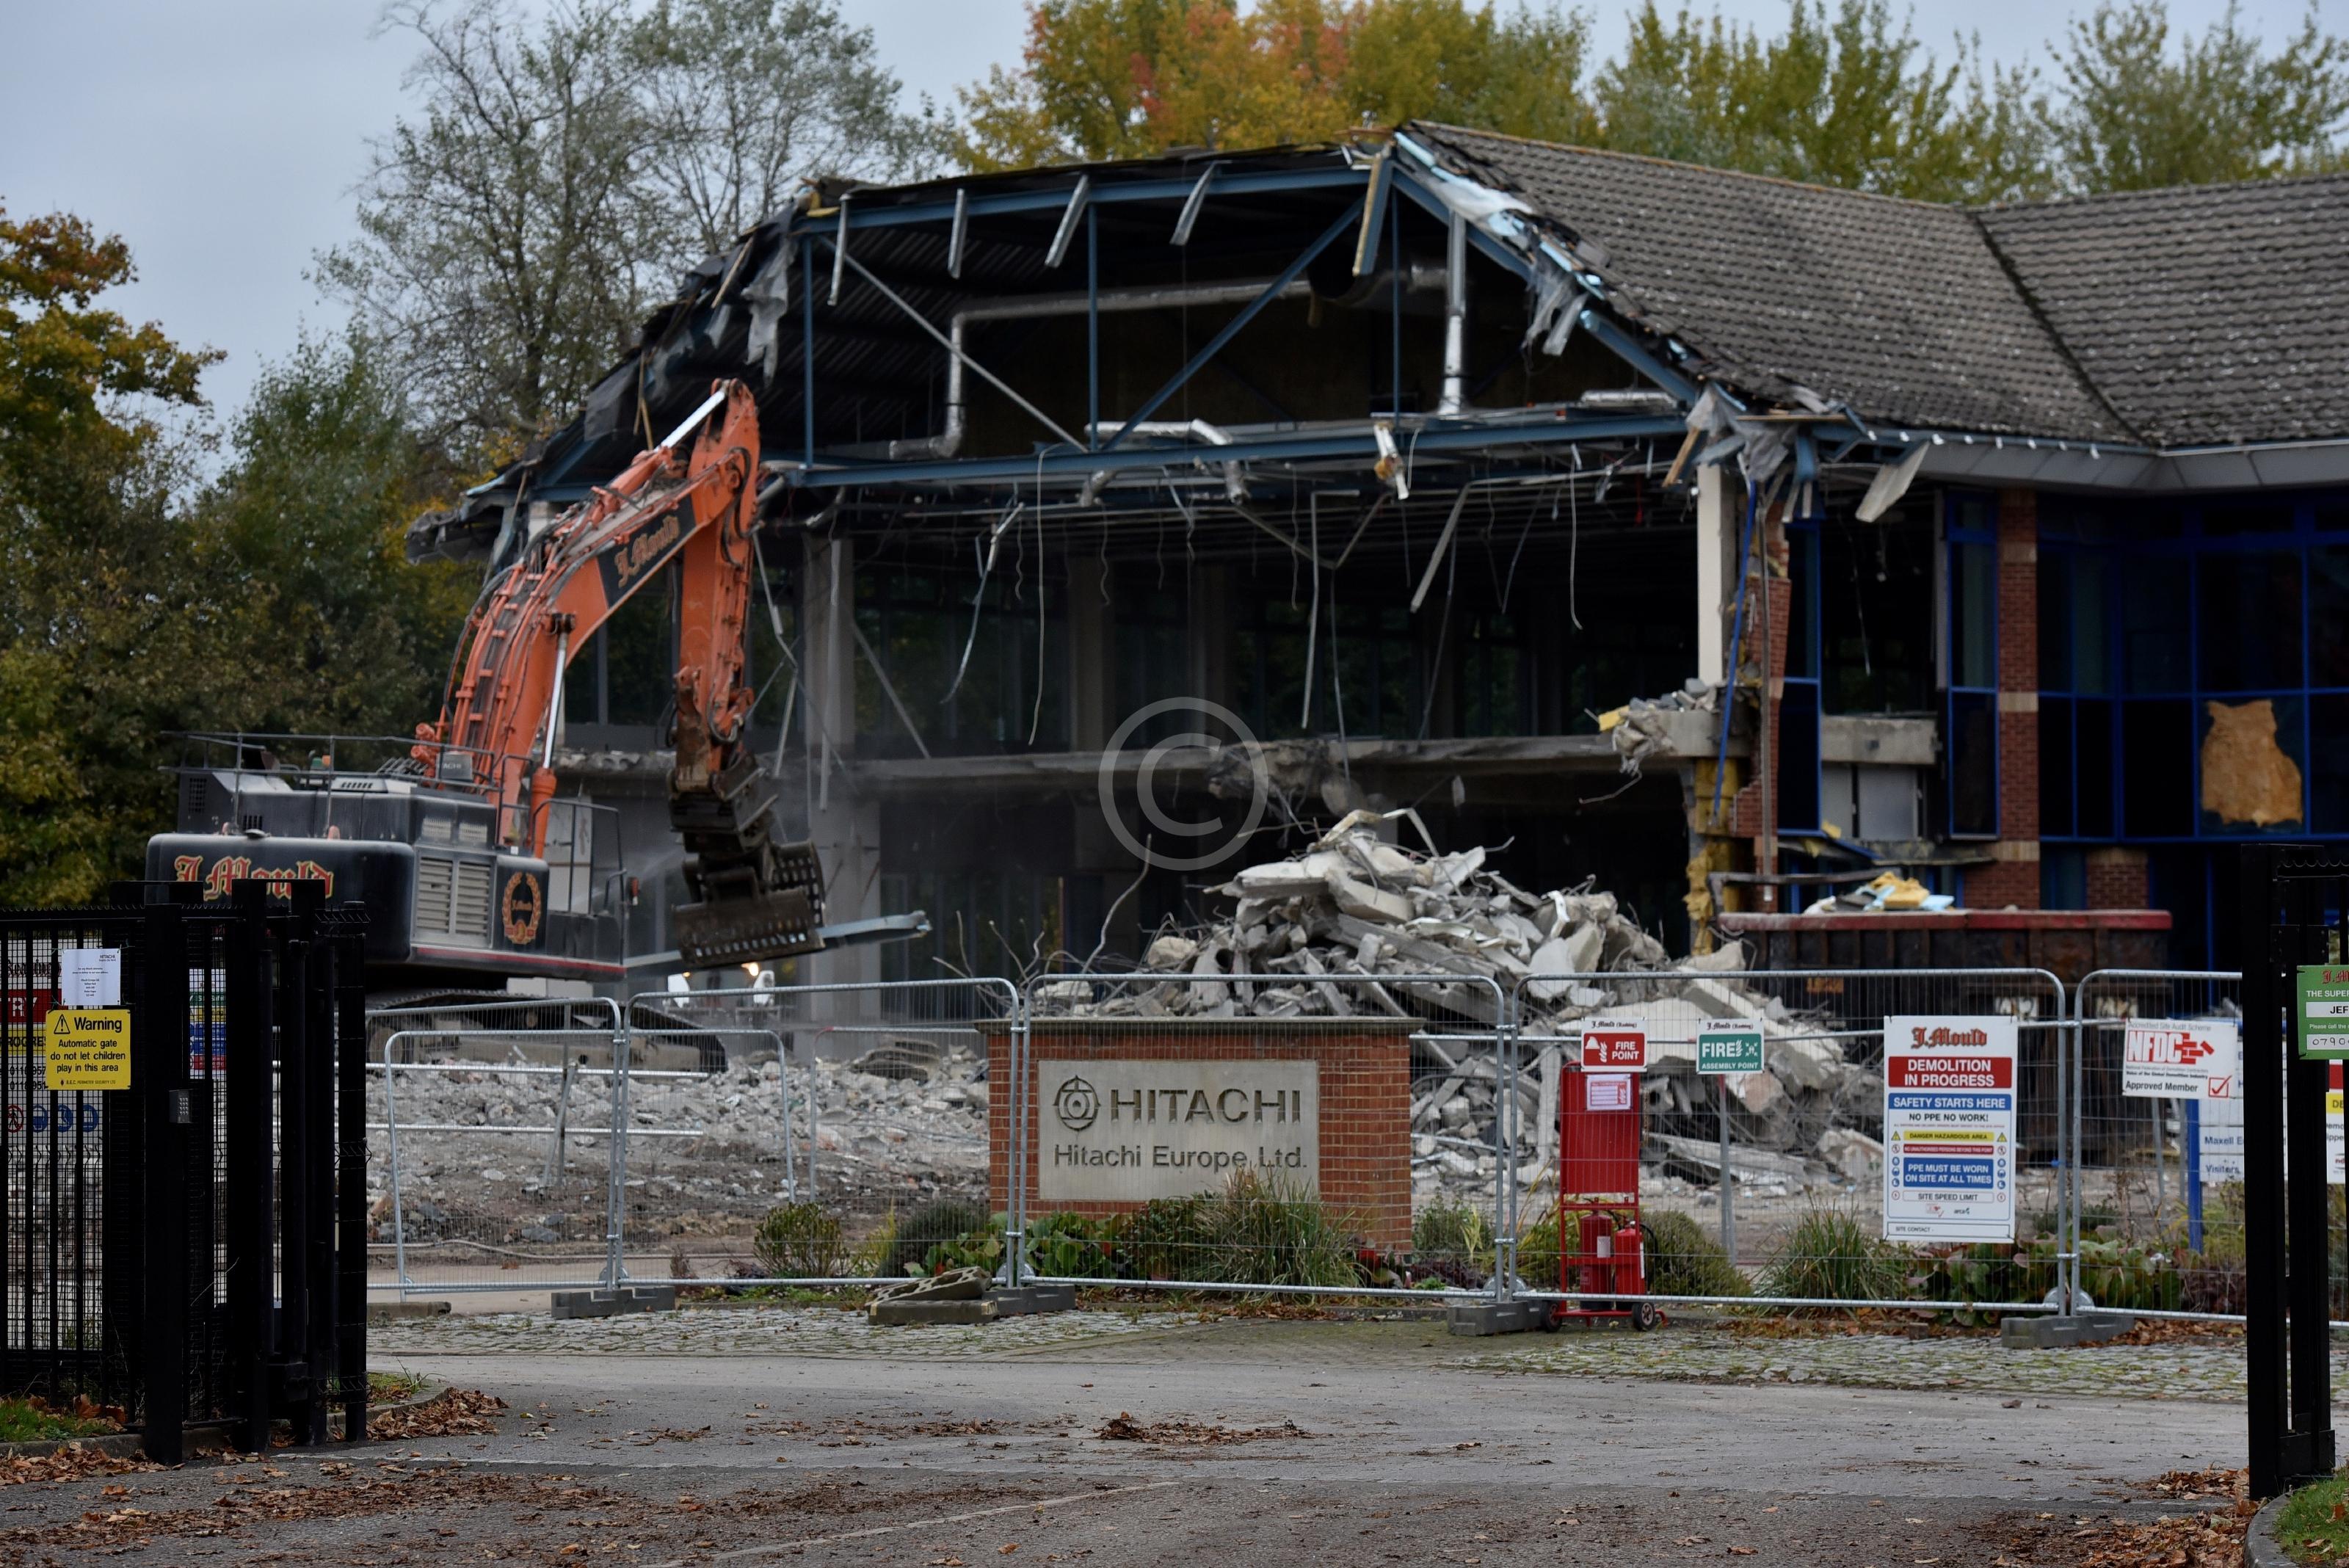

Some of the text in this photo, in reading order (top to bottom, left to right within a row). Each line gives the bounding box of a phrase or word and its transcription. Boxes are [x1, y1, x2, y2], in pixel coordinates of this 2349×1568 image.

[73, 1017, 122, 1033] Warning
[59, 1039, 117, 1050] Automatic gate
[1615, 1041, 1636, 1050] FIRE
[2312, 1037, 2349, 1046] 0790
[1702, 1042, 1735, 1058] FIRE
[2128, 1031, 2183, 1064] NFDC
[50, 1050, 126, 1060] do not let children
[1611, 1050, 1640, 1060] POINT
[57, 1063, 72, 1073] play
[75, 1063, 81, 1072] in
[84, 1063, 98, 1072] this
[1738, 1061, 1759, 1070] POINT
[1908, 1059, 1992, 1072] DEMOLITION
[1904, 1074, 1994, 1086] IN PROGRESS
[2126, 1081, 2199, 1092] Approved Member
[1110, 1088, 1301, 1124] HITACHI
[1894, 1097, 2005, 1108] SAFETY STARTS HERE
[1909, 1113, 1989, 1122] NO PPE NO WORK!
[2204, 1136, 2234, 1144] Maxell
[1054, 1144, 1307, 1174] Hitachi Europe Ltd.
[1908, 1164, 1989, 1173] PPE MUST BE WORN
[2206, 1164, 2239, 1174] Visitors
[1905, 1174, 1992, 1184] ON SITE AT ALL TIMES
